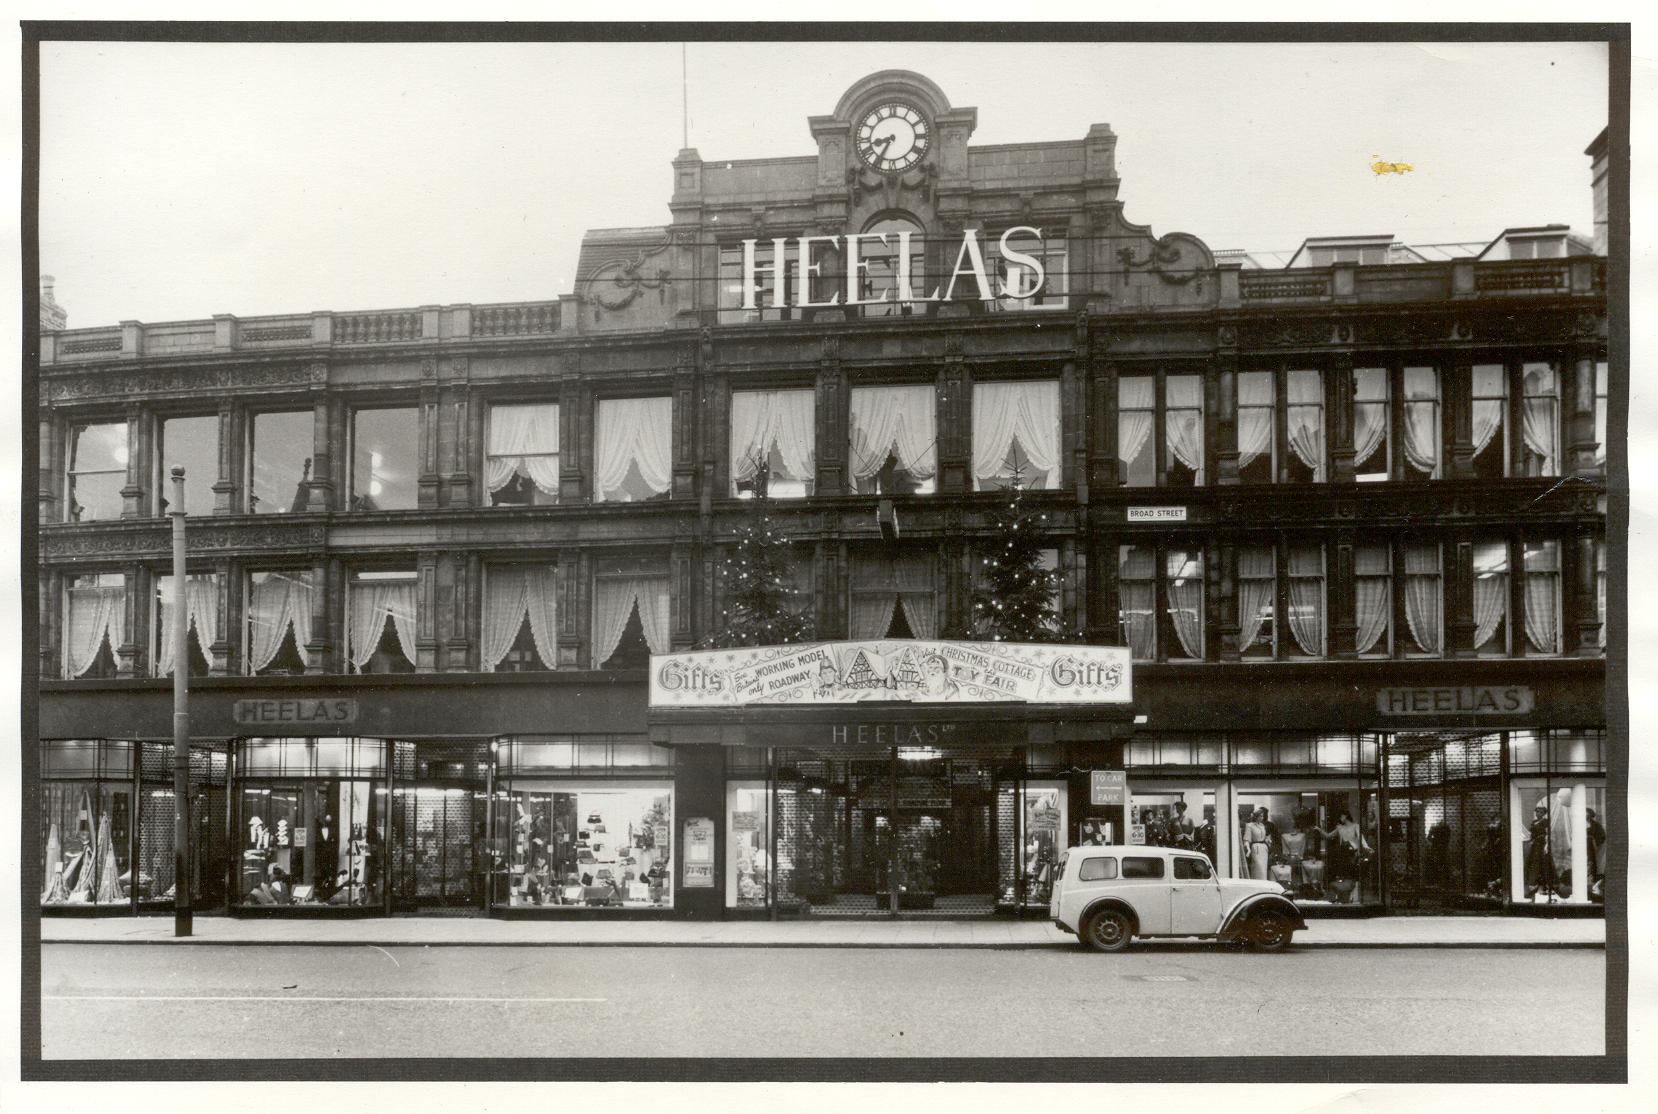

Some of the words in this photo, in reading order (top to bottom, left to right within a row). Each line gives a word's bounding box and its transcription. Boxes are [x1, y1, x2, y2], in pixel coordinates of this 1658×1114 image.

[741, 226, 1045, 309] HEELAS
[1157, 509, 1184, 517] STREET
[755, 658, 795, 678] WORKING
[798, 649, 826, 666] MODEL
[942, 646, 989, 668] CHRISTMAS
[993, 660, 1034, 680] COTTAGE
[1050, 655, 1122, 690] Gifts
[657, 659, 724, 695] Gifts
[748, 682, 764, 696] only
[768, 670, 810, 690] ROADWAY
[985, 674, 1017, 691] FAIR
[242, 701, 349, 721] HEELAS
[1387, 688, 1520, 711] HEELAS
[832, 724, 938, 744] HEELAS
[1094, 774, 1106, 783] TO
[1107, 774, 1123, 783] CAR
[1097, 793, 1120, 801] PARK
